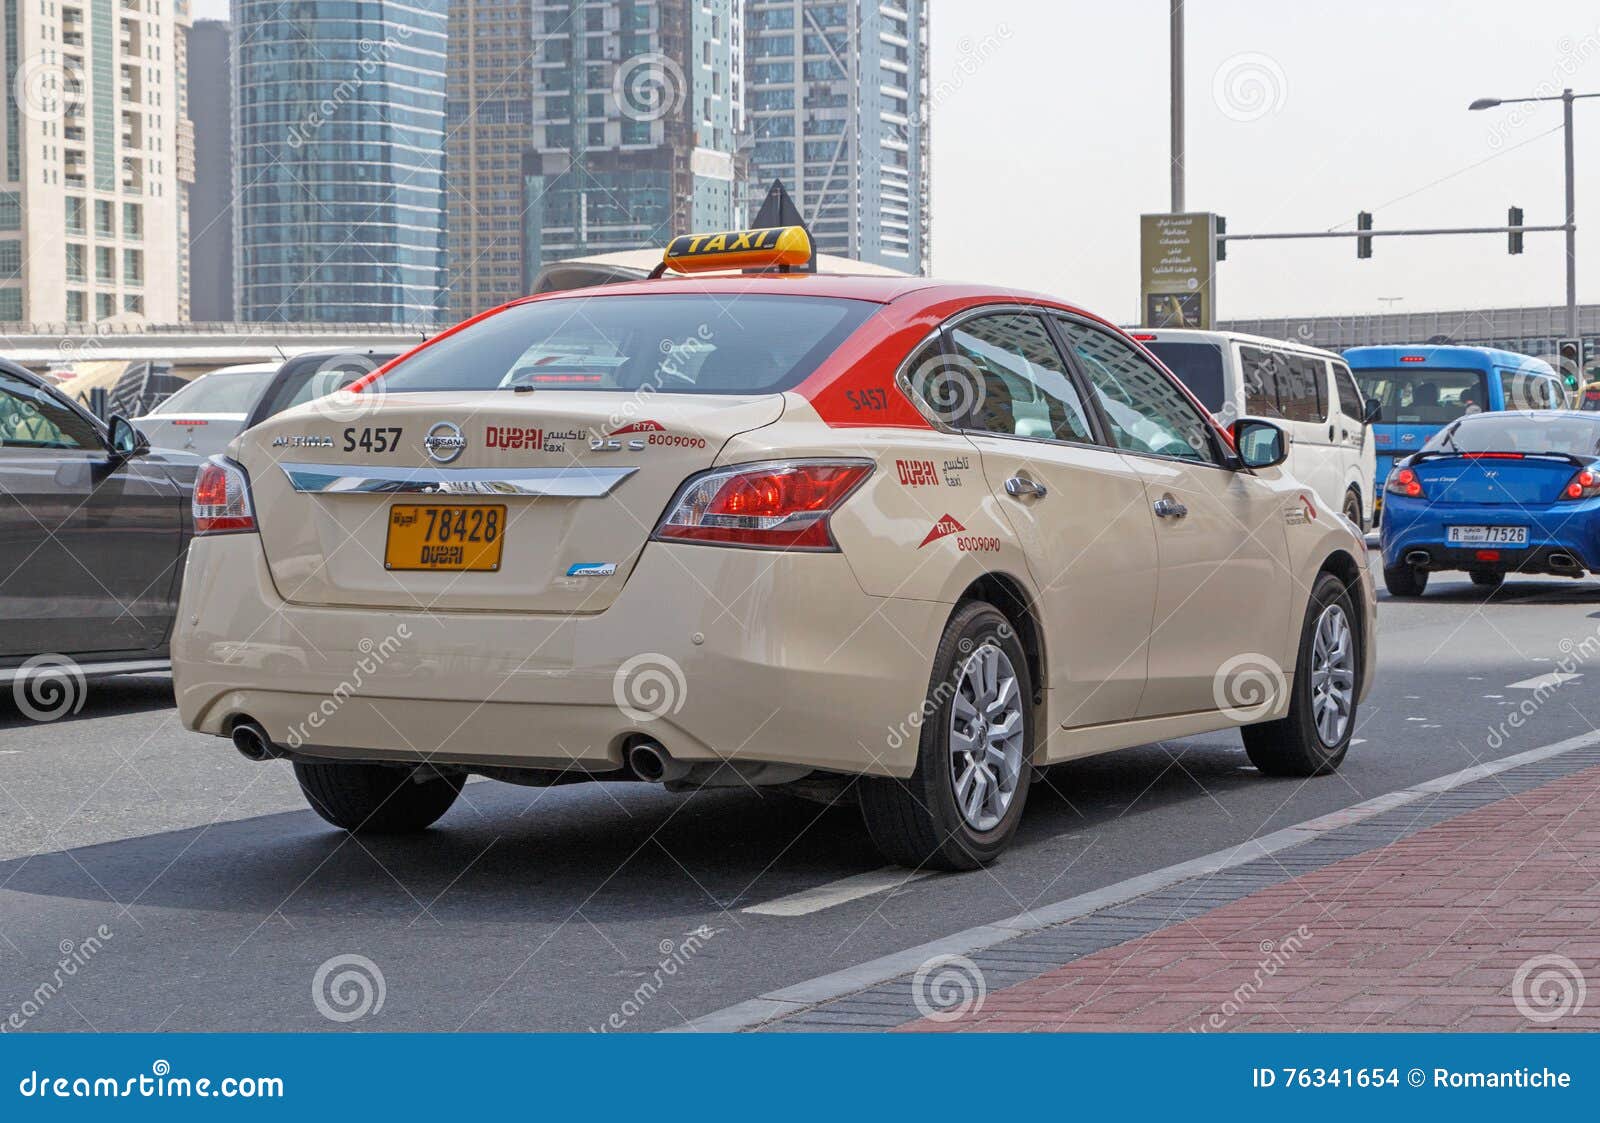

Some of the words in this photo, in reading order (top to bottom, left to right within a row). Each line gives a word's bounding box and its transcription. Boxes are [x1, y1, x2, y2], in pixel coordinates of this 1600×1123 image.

[688, 231, 769, 253] TAXI
[846, 388, 888, 411] S457
[632, 422, 656, 431] RTA
[272, 434, 335, 448] ALTIMA
[344, 427, 403, 453] S457
[424, 436, 466, 448] NISSAN
[486, 426, 543, 450] DUBAI
[648, 434, 706, 449] 8009090
[543, 441, 566, 453] taxi
[896, 459, 939, 488] DUBAI
[945, 474, 962, 487] taxi
[425, 509, 498, 542] 78428
[936, 520, 959, 534] RTA
[1453, 528, 1459, 540] R
[1485, 527, 1525, 541] 77526
[957, 536, 1001, 552] 8009090
[420, 545, 464, 567] DUBAI
